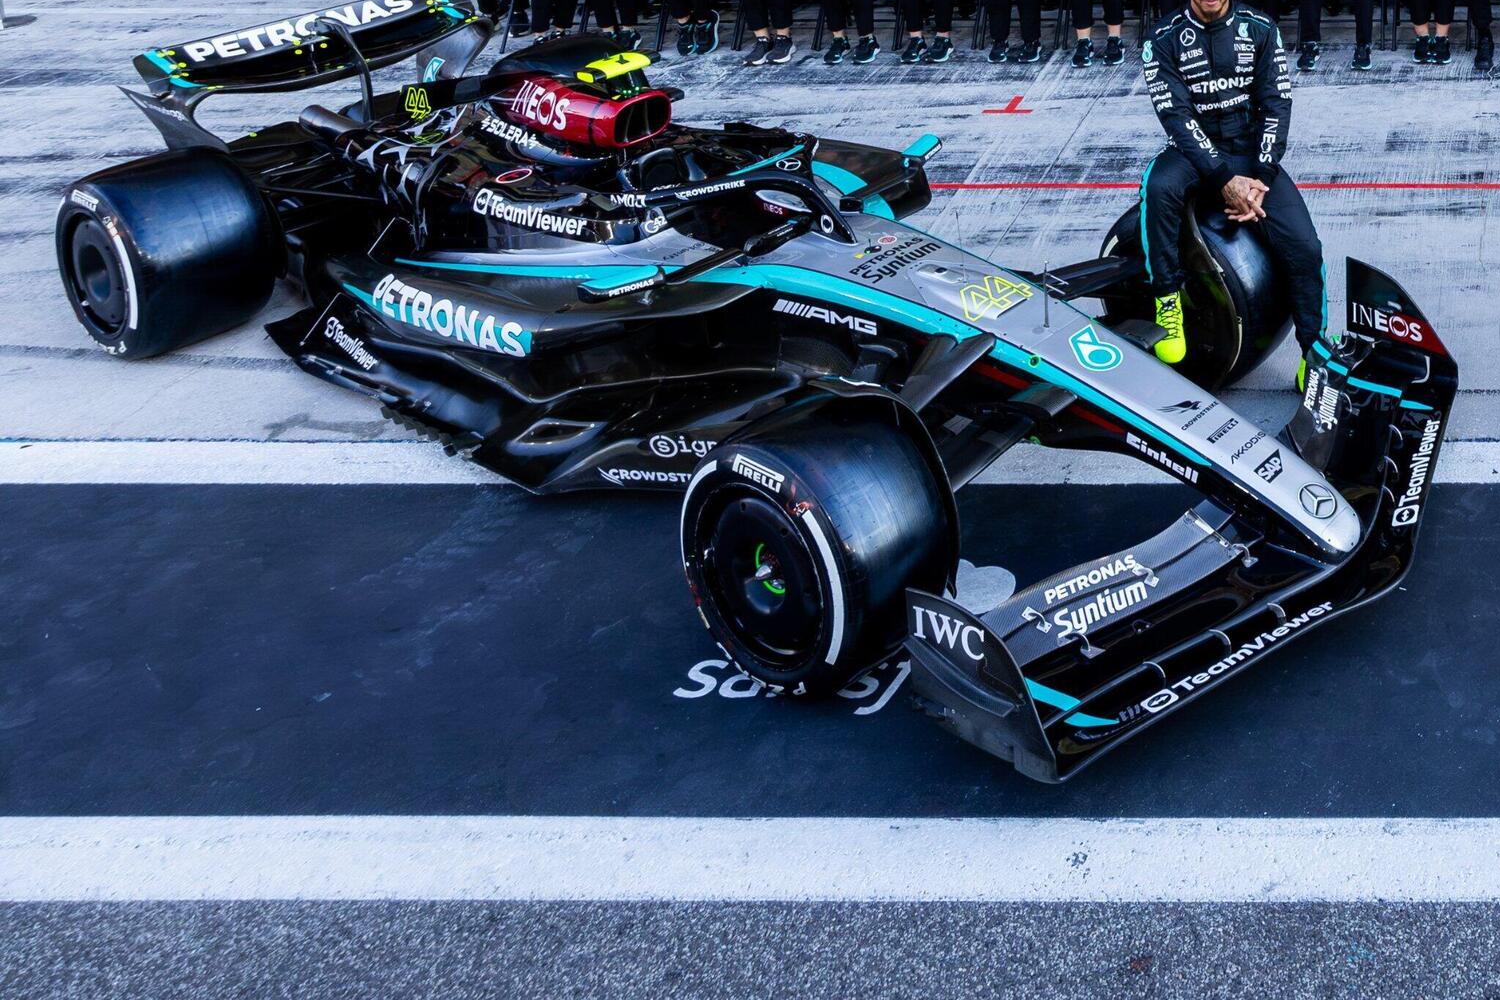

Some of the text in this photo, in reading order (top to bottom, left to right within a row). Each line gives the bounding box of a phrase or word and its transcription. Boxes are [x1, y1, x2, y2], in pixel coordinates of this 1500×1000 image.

[1187, 48, 1204, 59] UBS
[510, 80, 570, 131] INEOS
[490, 117, 530, 147] SOLERA
[680, 180, 746, 198] CROWDSTRIKE
[490, 195, 588, 236] TeamViewer
[644, 216, 668, 234] G42
[850, 237, 924, 276] PETRONAS
[861, 241, 942, 284] Syntium
[608, 278, 655, 298] PETRONAS
[959, 275, 1034, 323] 44
[371, 273, 526, 359] PETRONAS
[805, 306, 878, 336] AMG
[1351, 301, 1425, 343] INEOS
[334, 323, 378, 372] TeamViewer
[1303, 368, 1320, 413] PETRONAS
[1180, 400, 1219, 432] CROWDSTRIKE
[1206, 418, 1240, 444] PIRELLI
[1125, 432, 1200, 485] Einhell
[1230, 431, 1267, 465] AKKODIS
[1257, 455, 1283, 482] SAP
[1399, 418, 1441, 509] TeamViewer
[732, 453, 785, 493] PIRELLI
[1043, 553, 1139, 605] PETRONAS
[1053, 580, 1149, 640] Syntium
[912, 605, 987, 661] IWC
[1172, 600, 1334, 693] TeamViewer
